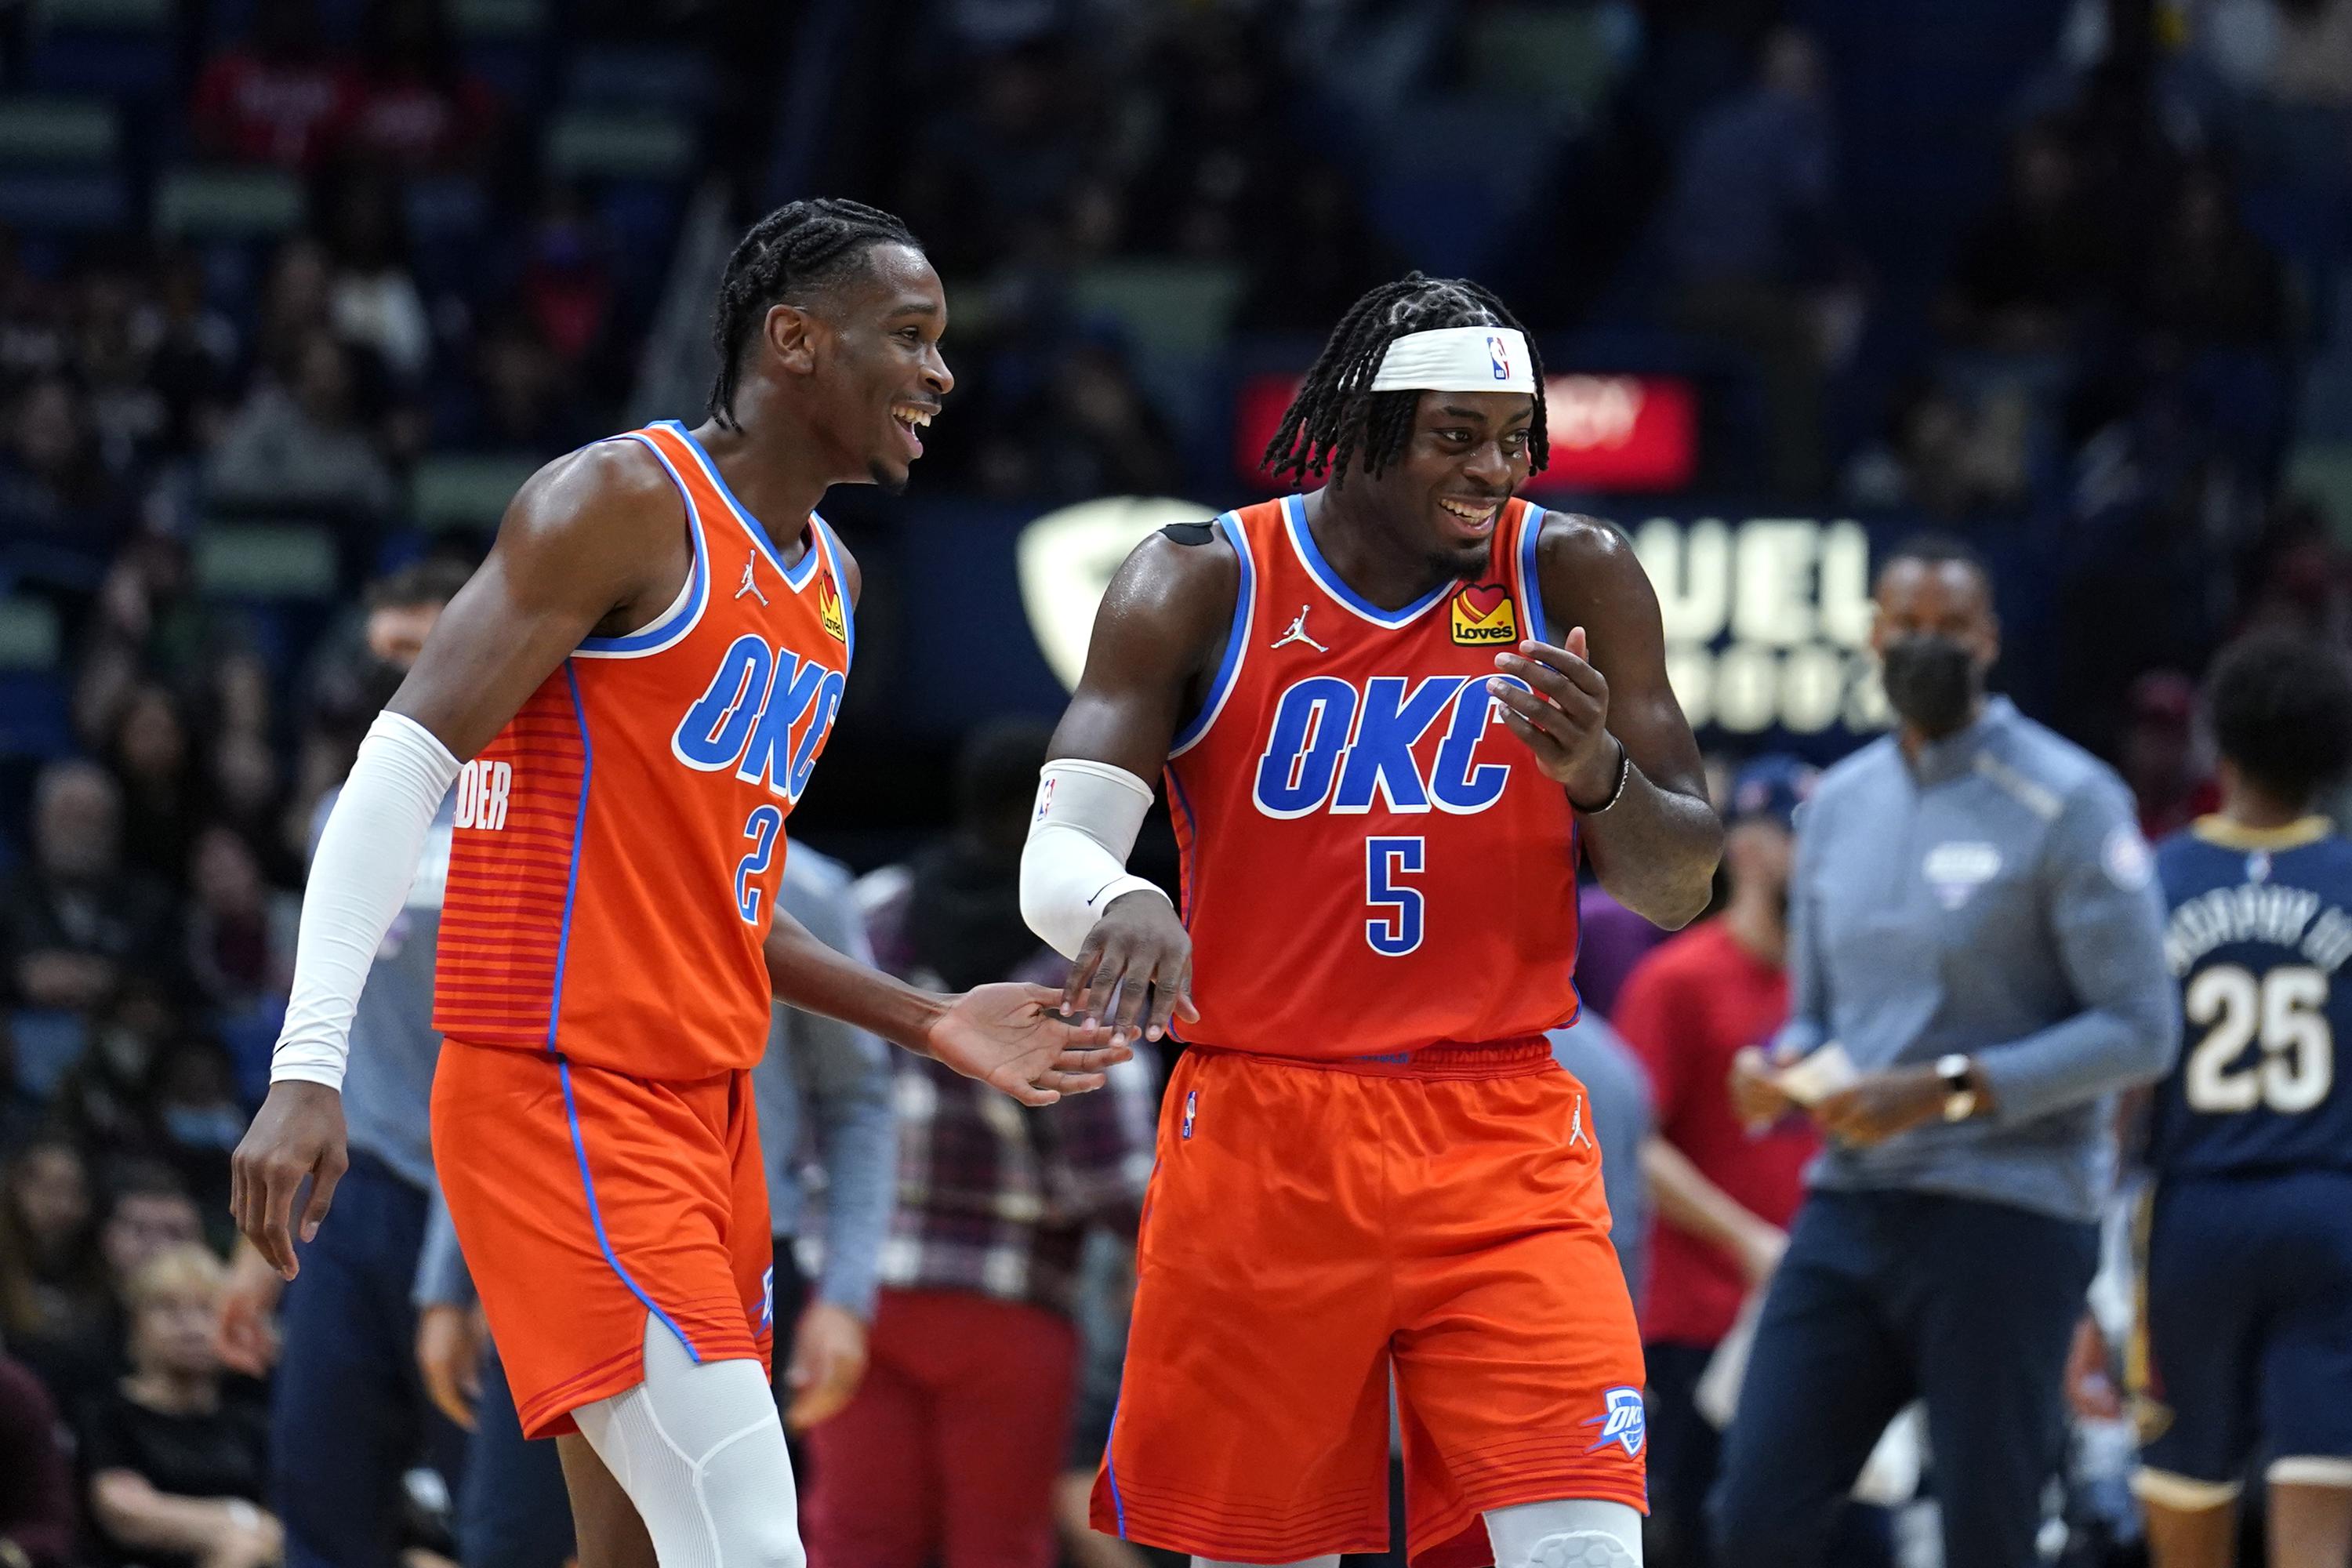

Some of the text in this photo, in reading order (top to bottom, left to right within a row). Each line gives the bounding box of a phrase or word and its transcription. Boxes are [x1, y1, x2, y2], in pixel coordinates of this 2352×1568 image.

[671, 633, 845, 805] OKC
[1252, 673, 1537, 820] OKC
[735, 804, 783, 926] 2
[1366, 836, 1425, 956] 5
[2186, 964, 2334, 1112] 25
